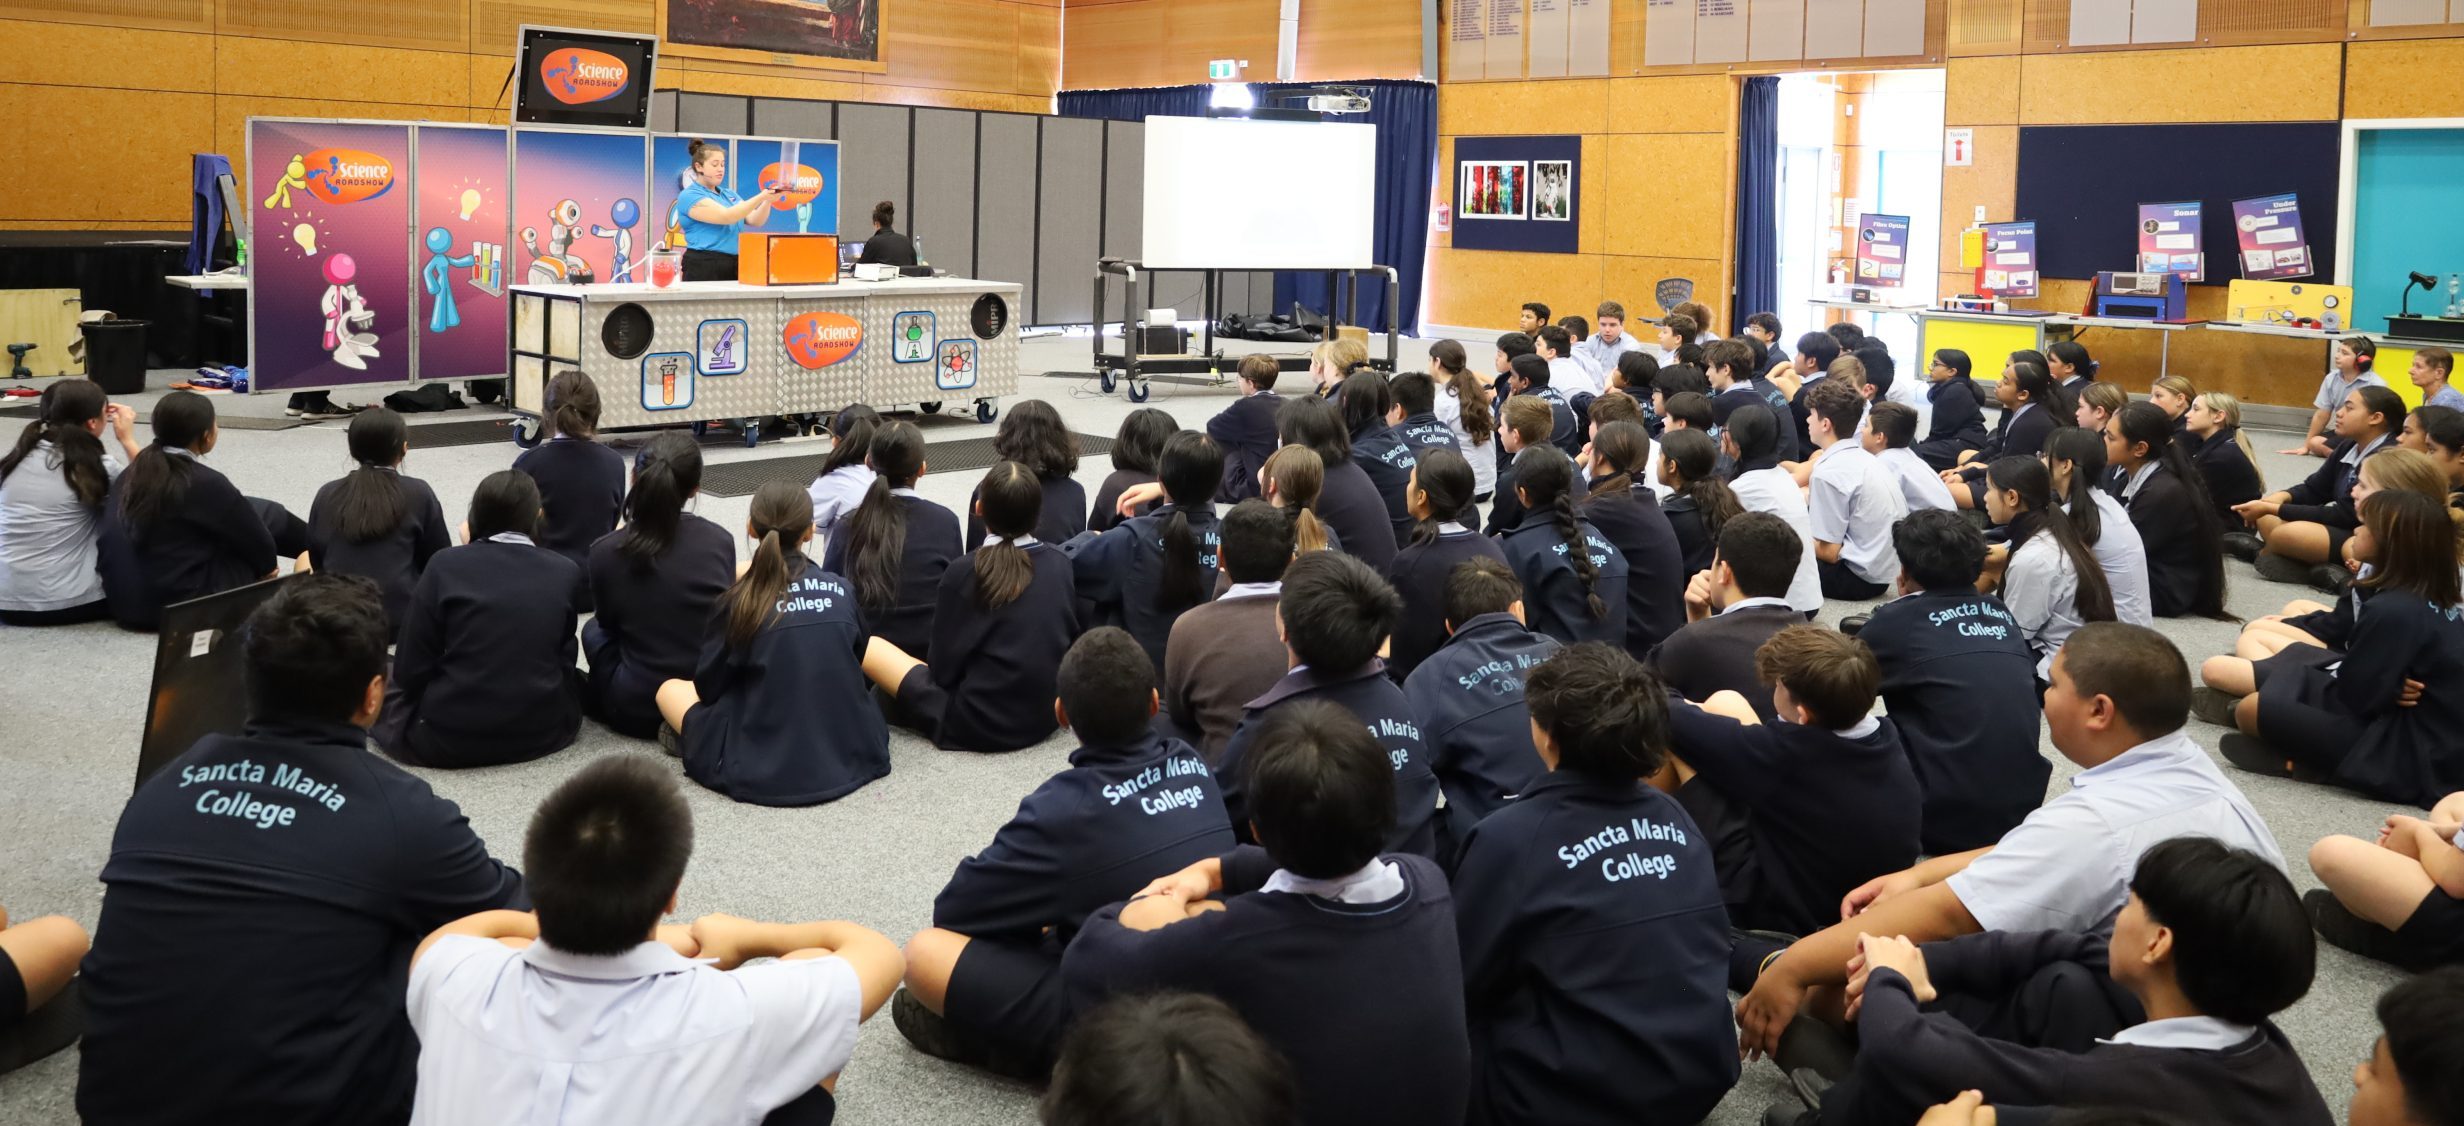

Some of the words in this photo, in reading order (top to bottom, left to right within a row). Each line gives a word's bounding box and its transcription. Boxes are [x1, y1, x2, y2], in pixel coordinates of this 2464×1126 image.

[577, 62, 624, 80] Science
[572, 79, 618, 88] ROADSHOW
[339, 162, 389, 178] Science
[2173, 209, 2199, 217] Sonar
[2264, 206, 2297, 215] Pressure
[2273, 200, 2297, 209] Under
[817, 325, 858, 341] Science
[813, 341, 854, 349] ROADSHOW
[1406, 424, 1433, 438] Sancta
[1421, 434, 1451, 445] College
[1586, 535, 1614, 555] Maria
[803, 578, 845, 597] Maria
[775, 596, 833, 613] College
[1928, 602, 1979, 627] Sancta
[1981, 601, 2014, 627] Maria
[1957, 622, 2008, 641] College
[1379, 718, 1420, 742] Maria
[178, 759, 266, 788] Sancta
[271, 763, 347, 812] Maria
[1102, 766, 1162, 806] Sancta
[1165, 756, 1209, 779] Maria
[195, 789, 297, 829] College
[1140, 785, 1205, 816] College
[1557, 825, 1630, 869] Sancta
[1631, 818, 1687, 846] Maria
[1601, 852, 1677, 882] College
